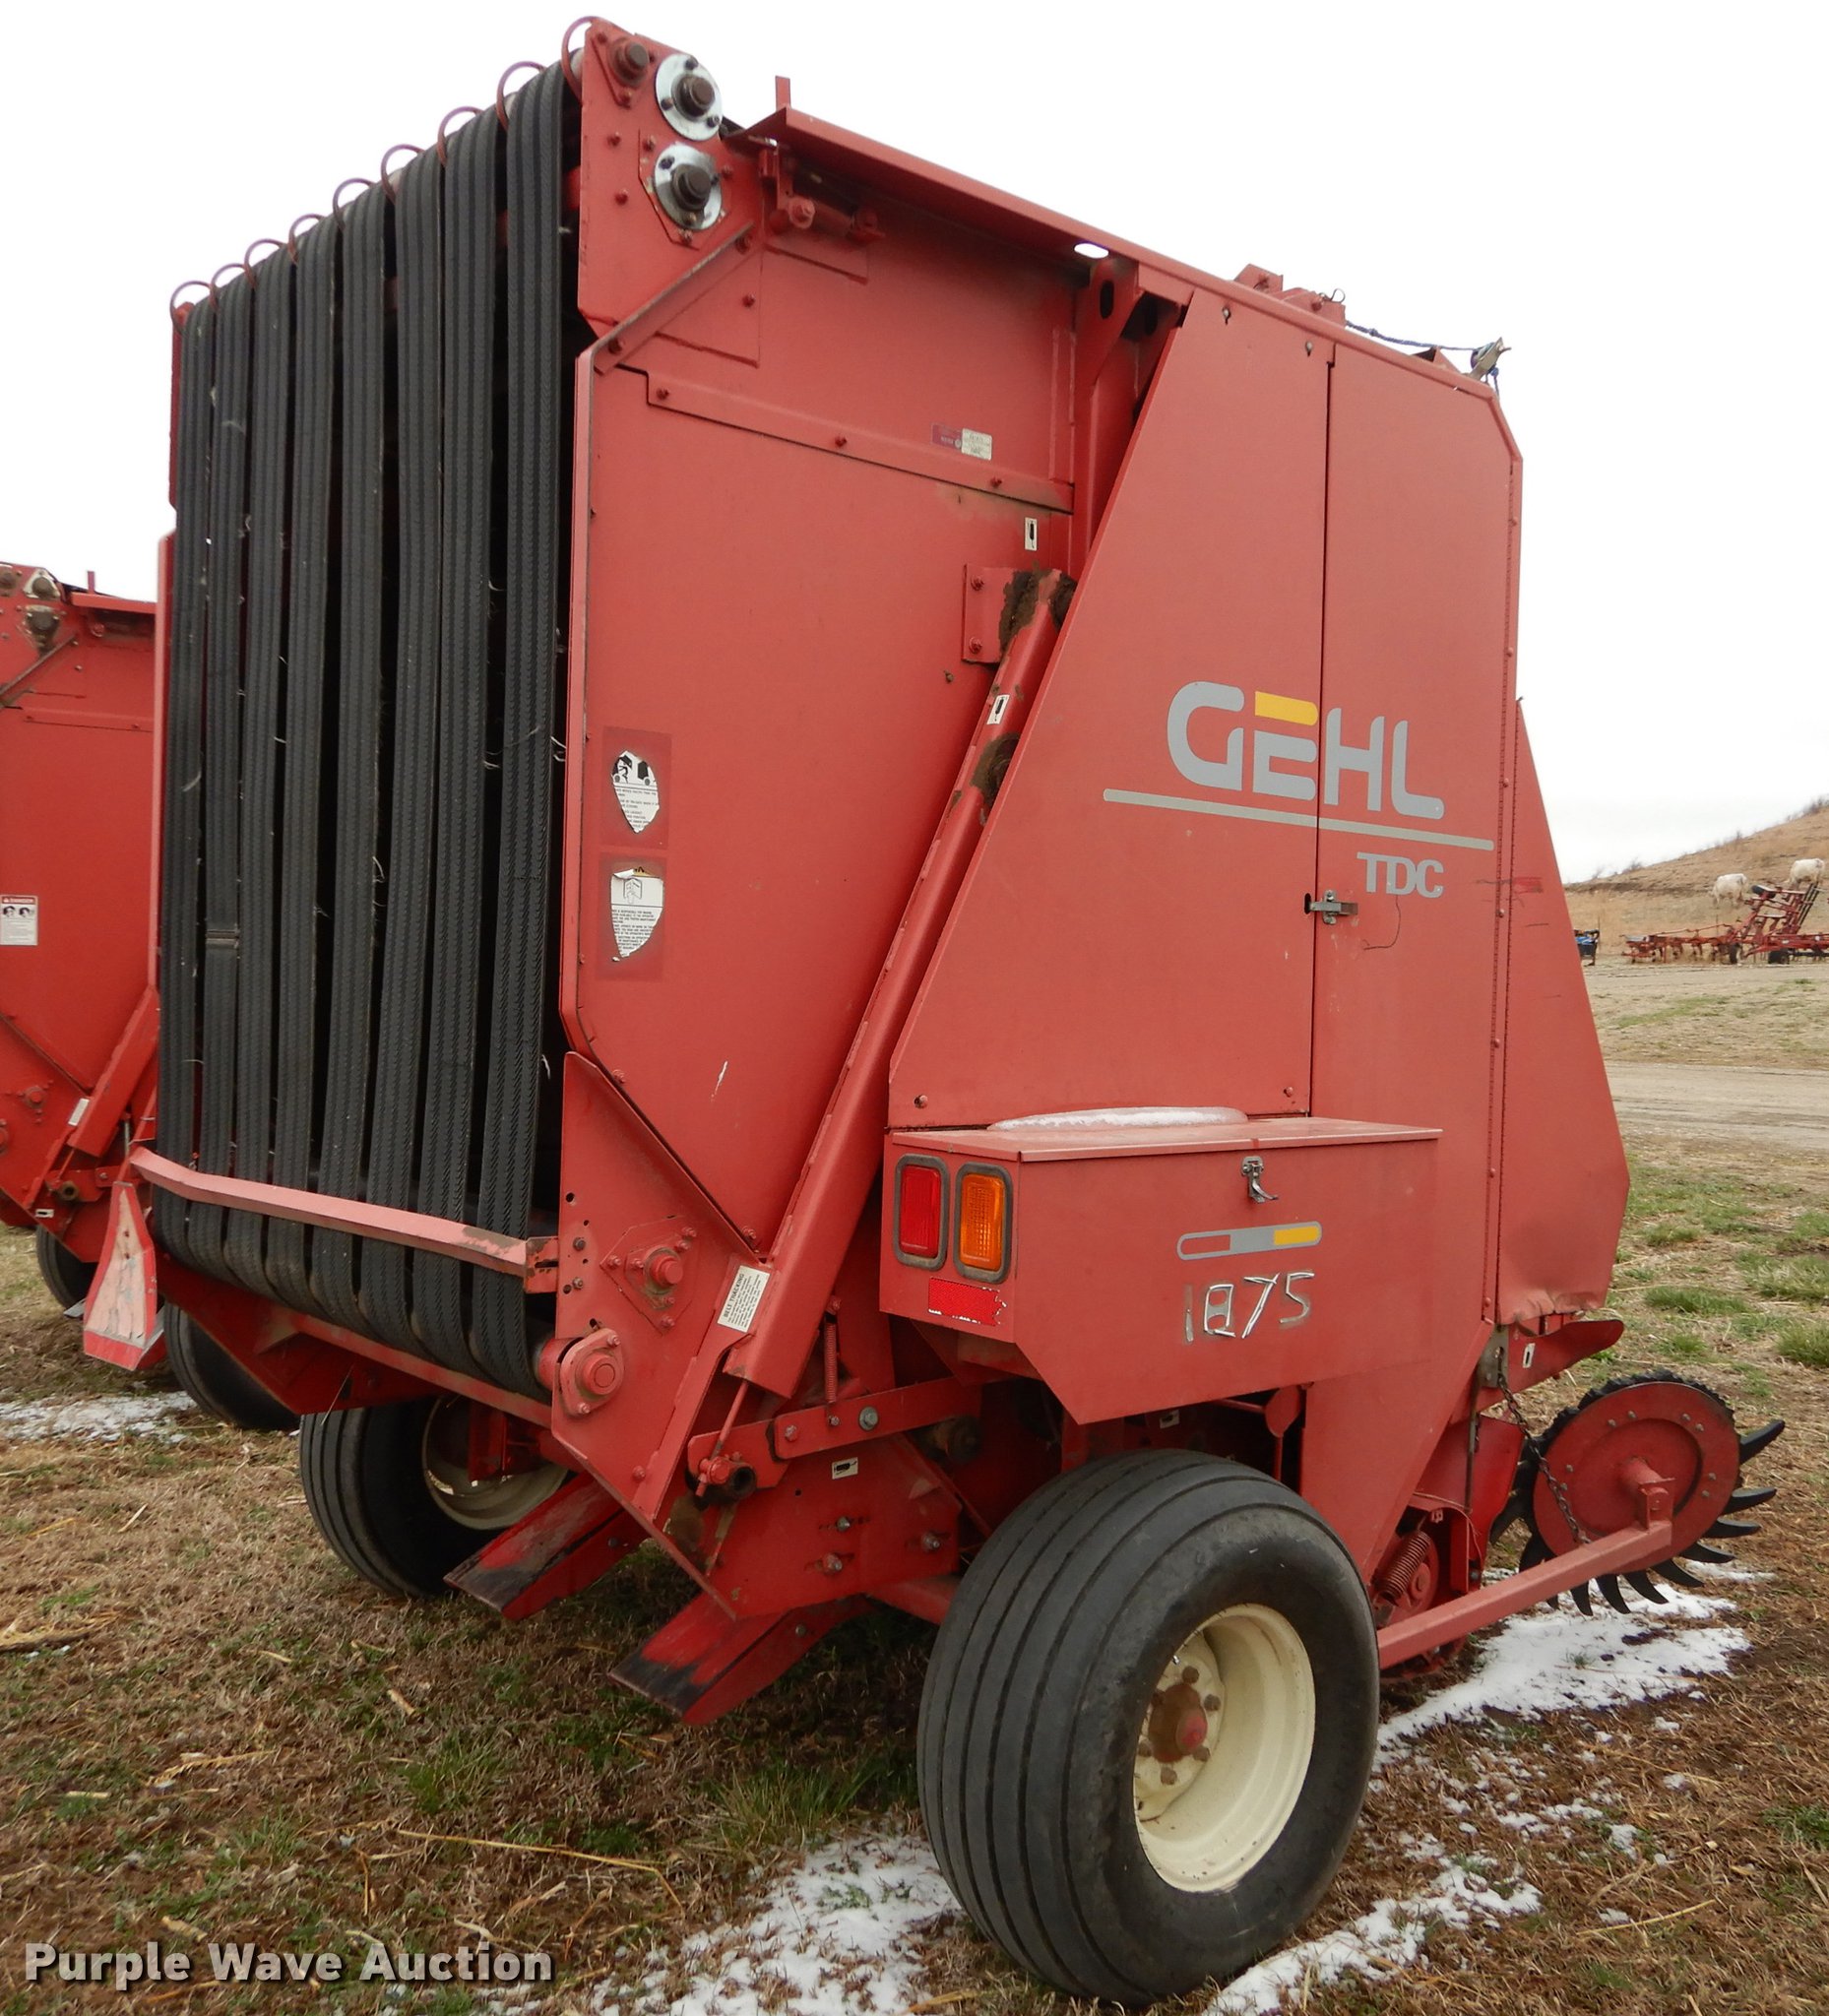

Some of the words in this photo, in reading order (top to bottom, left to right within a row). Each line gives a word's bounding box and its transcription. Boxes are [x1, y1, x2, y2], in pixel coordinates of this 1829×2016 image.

[1167, 681, 1444, 819] GEHL
[1356, 851, 1443, 898] TDC
[730, 1273, 744, 1302] TRACKING
[1184, 1272, 1315, 1342] 1875
